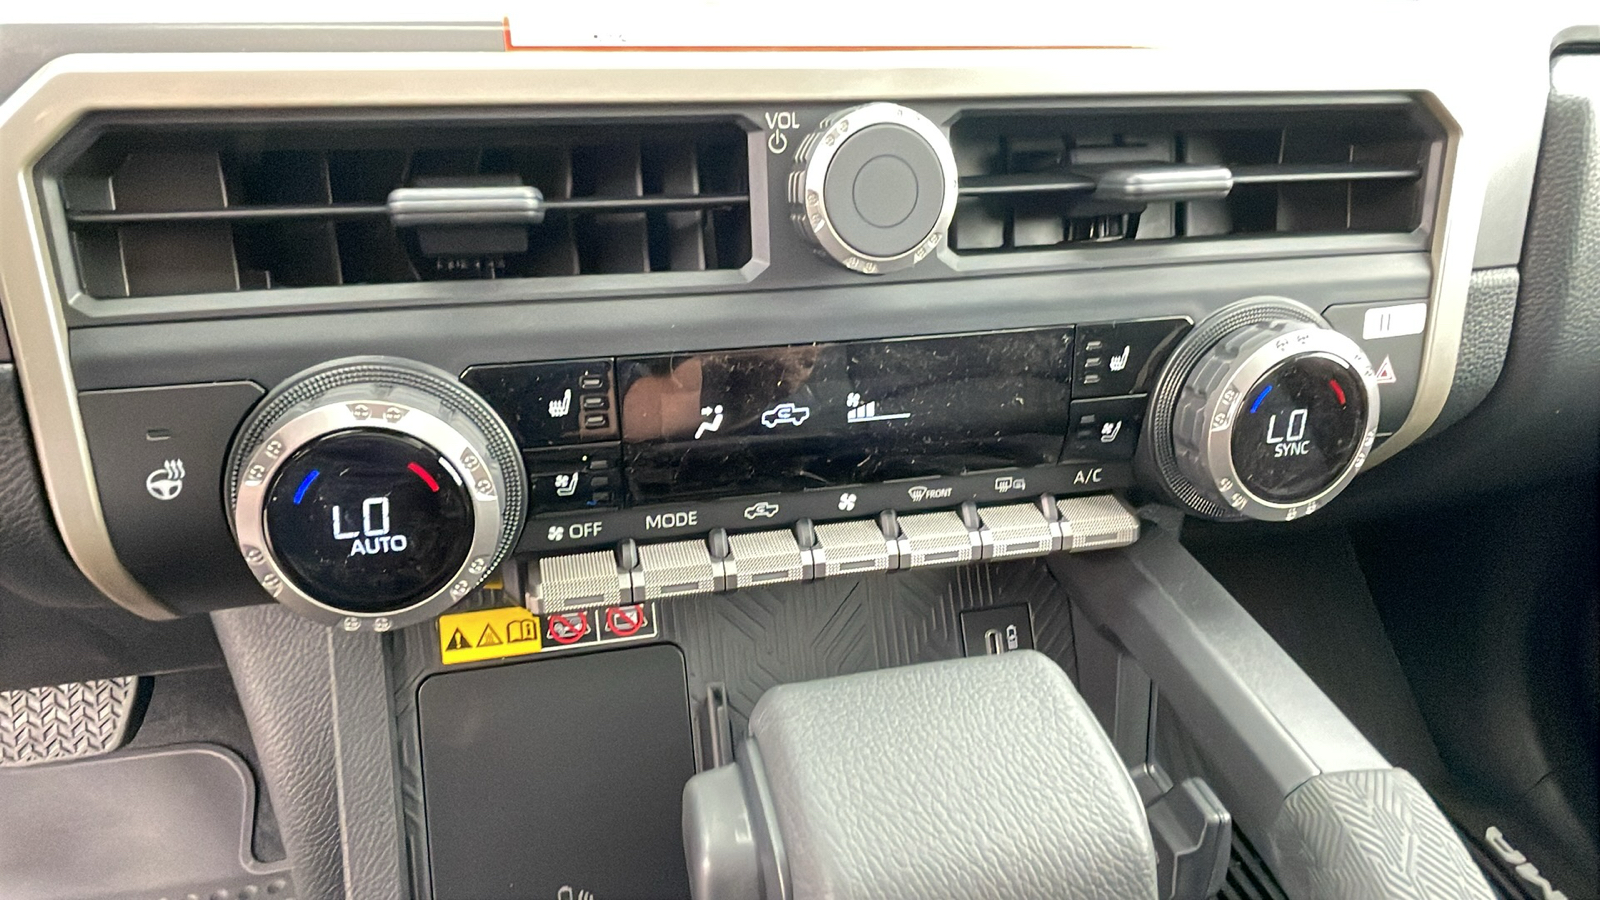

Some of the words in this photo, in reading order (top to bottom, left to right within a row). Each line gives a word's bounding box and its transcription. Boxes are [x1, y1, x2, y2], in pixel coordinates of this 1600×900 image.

[765, 111, 800, 129] VOL
[1266, 408, 1308, 444] LO
[1274, 440, 1311, 458] SYNC
[1073, 468, 1103, 485] A/C
[925, 487, 953, 500] FRONT
[332, 496, 390, 540] LO
[645, 511, 698, 530] MODE
[568, 521, 603, 539] OFF
[350, 534, 408, 557] AUTO
